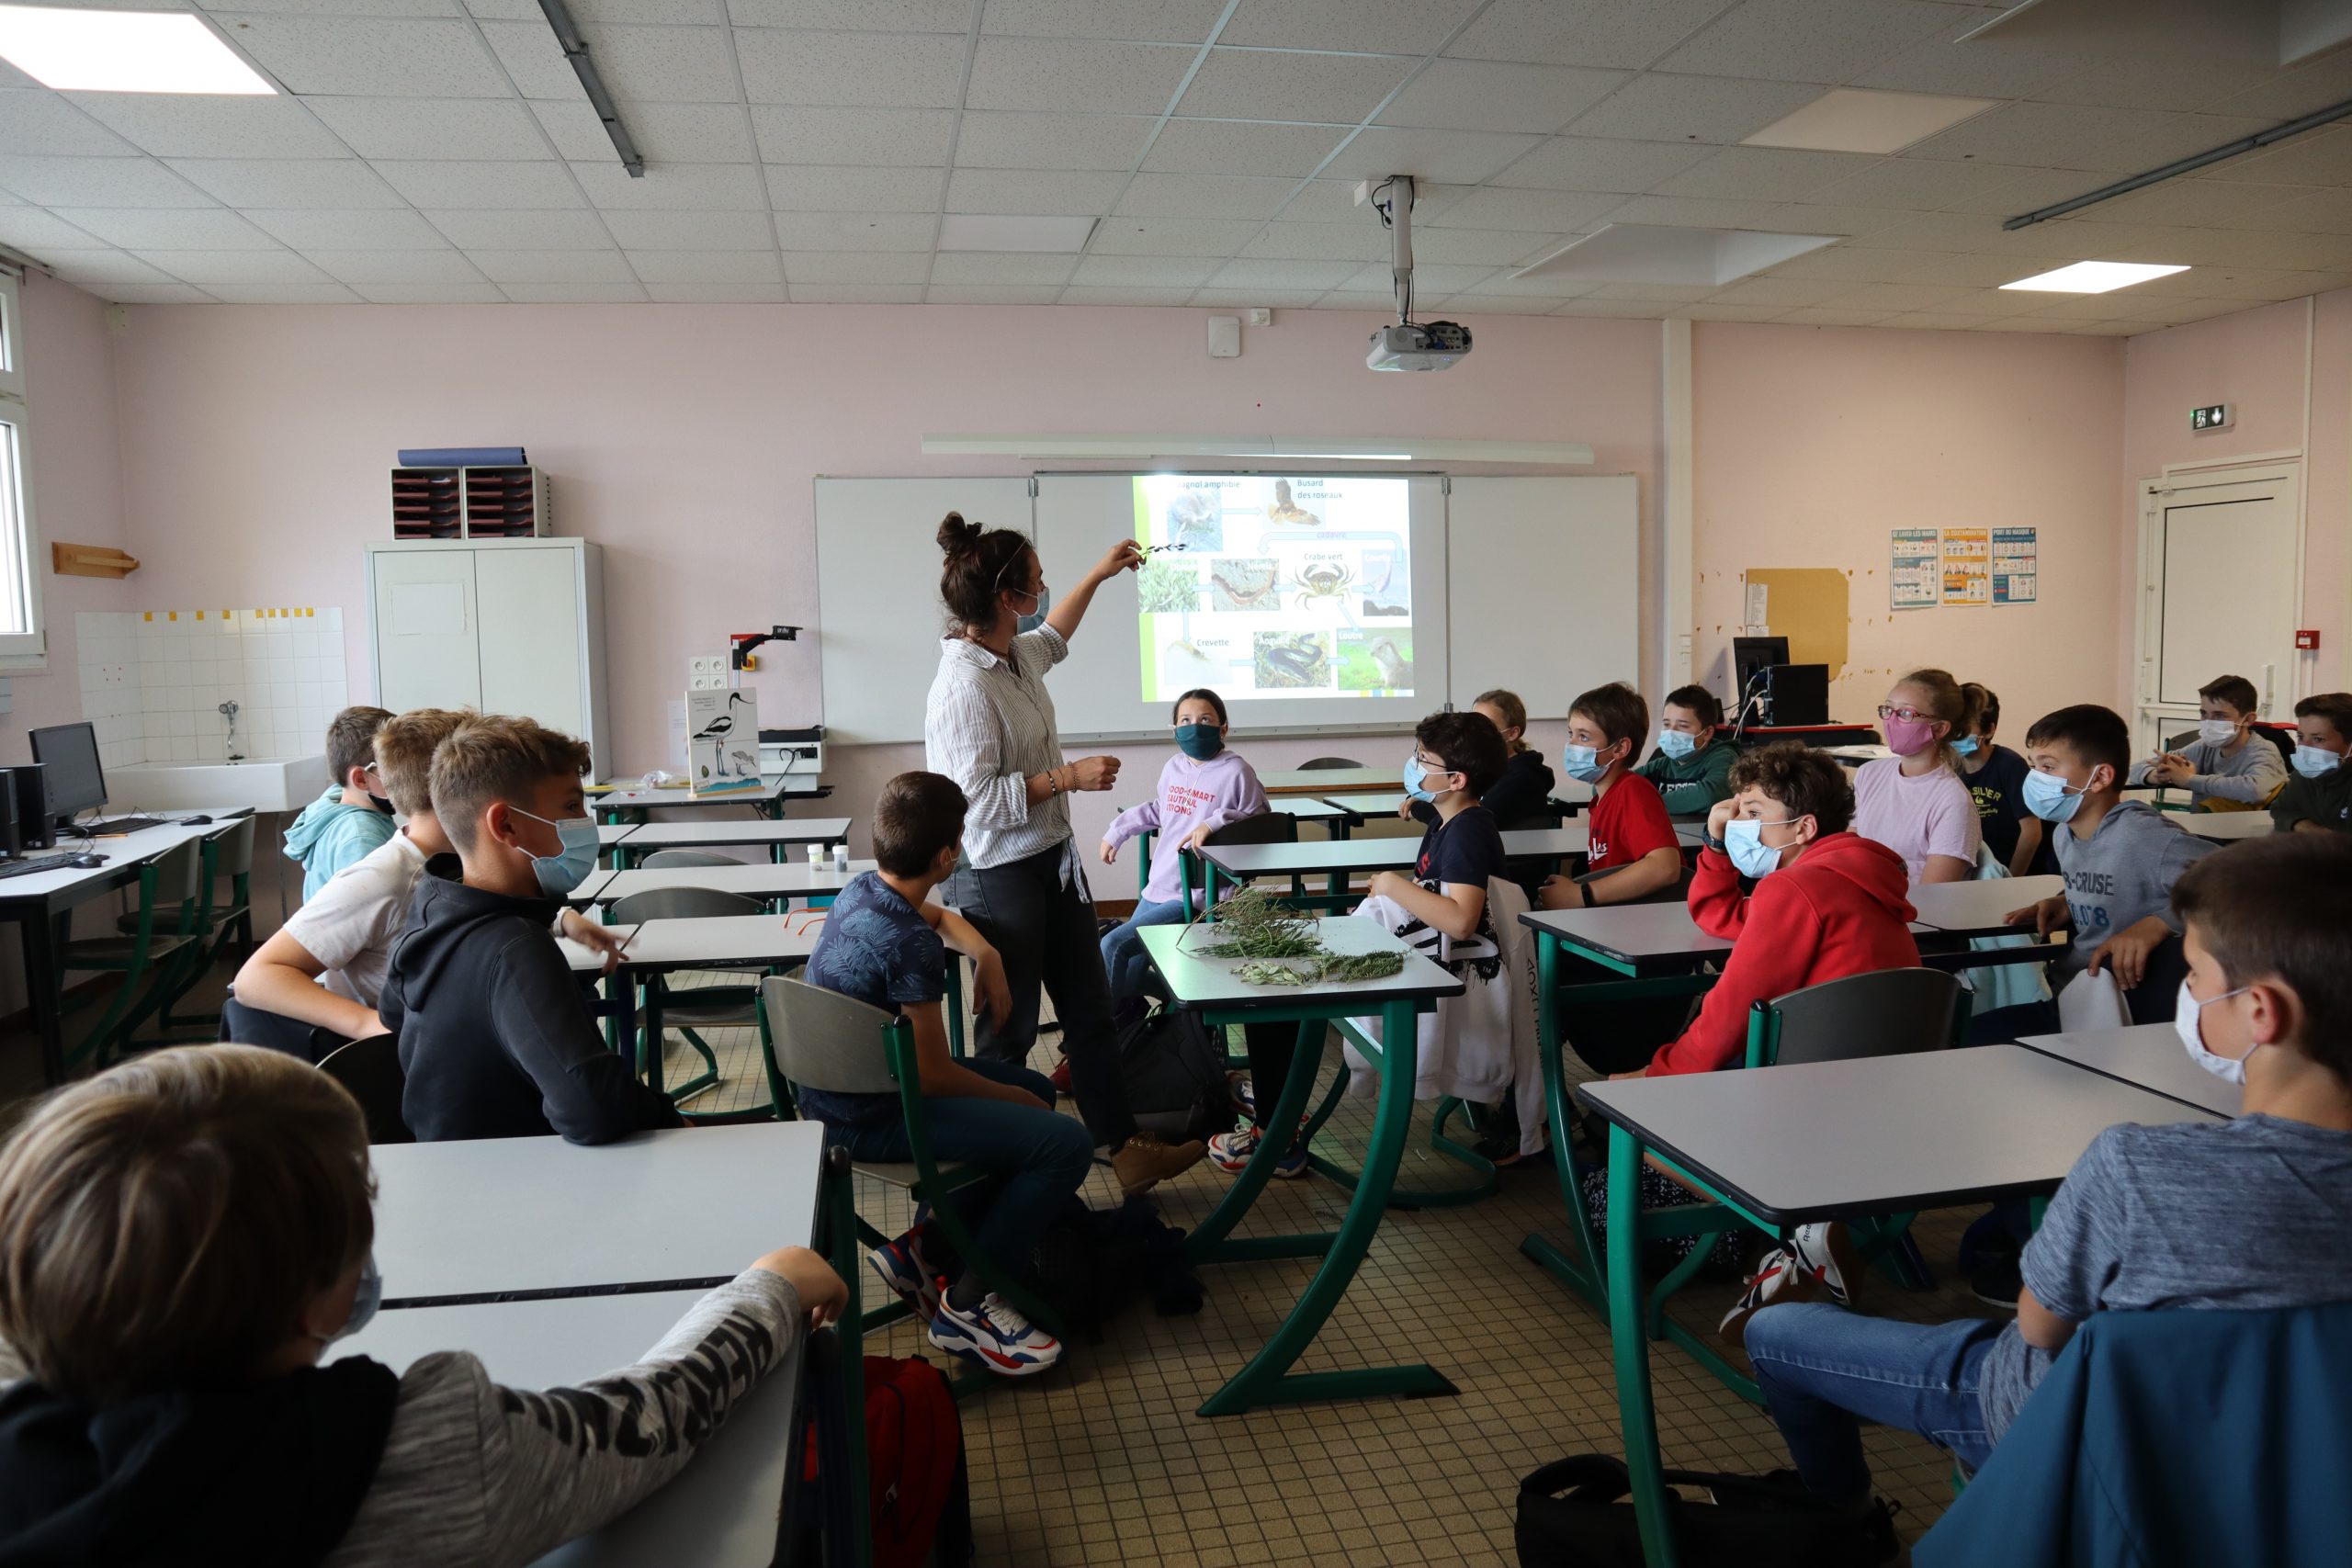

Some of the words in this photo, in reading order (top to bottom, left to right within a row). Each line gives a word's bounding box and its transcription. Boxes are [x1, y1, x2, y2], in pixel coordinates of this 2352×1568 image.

[1297, 479, 1324, 487] Busard
[1339, 631, 1363, 640] Loutre
[1196, 638, 1229, 647] Crevette
